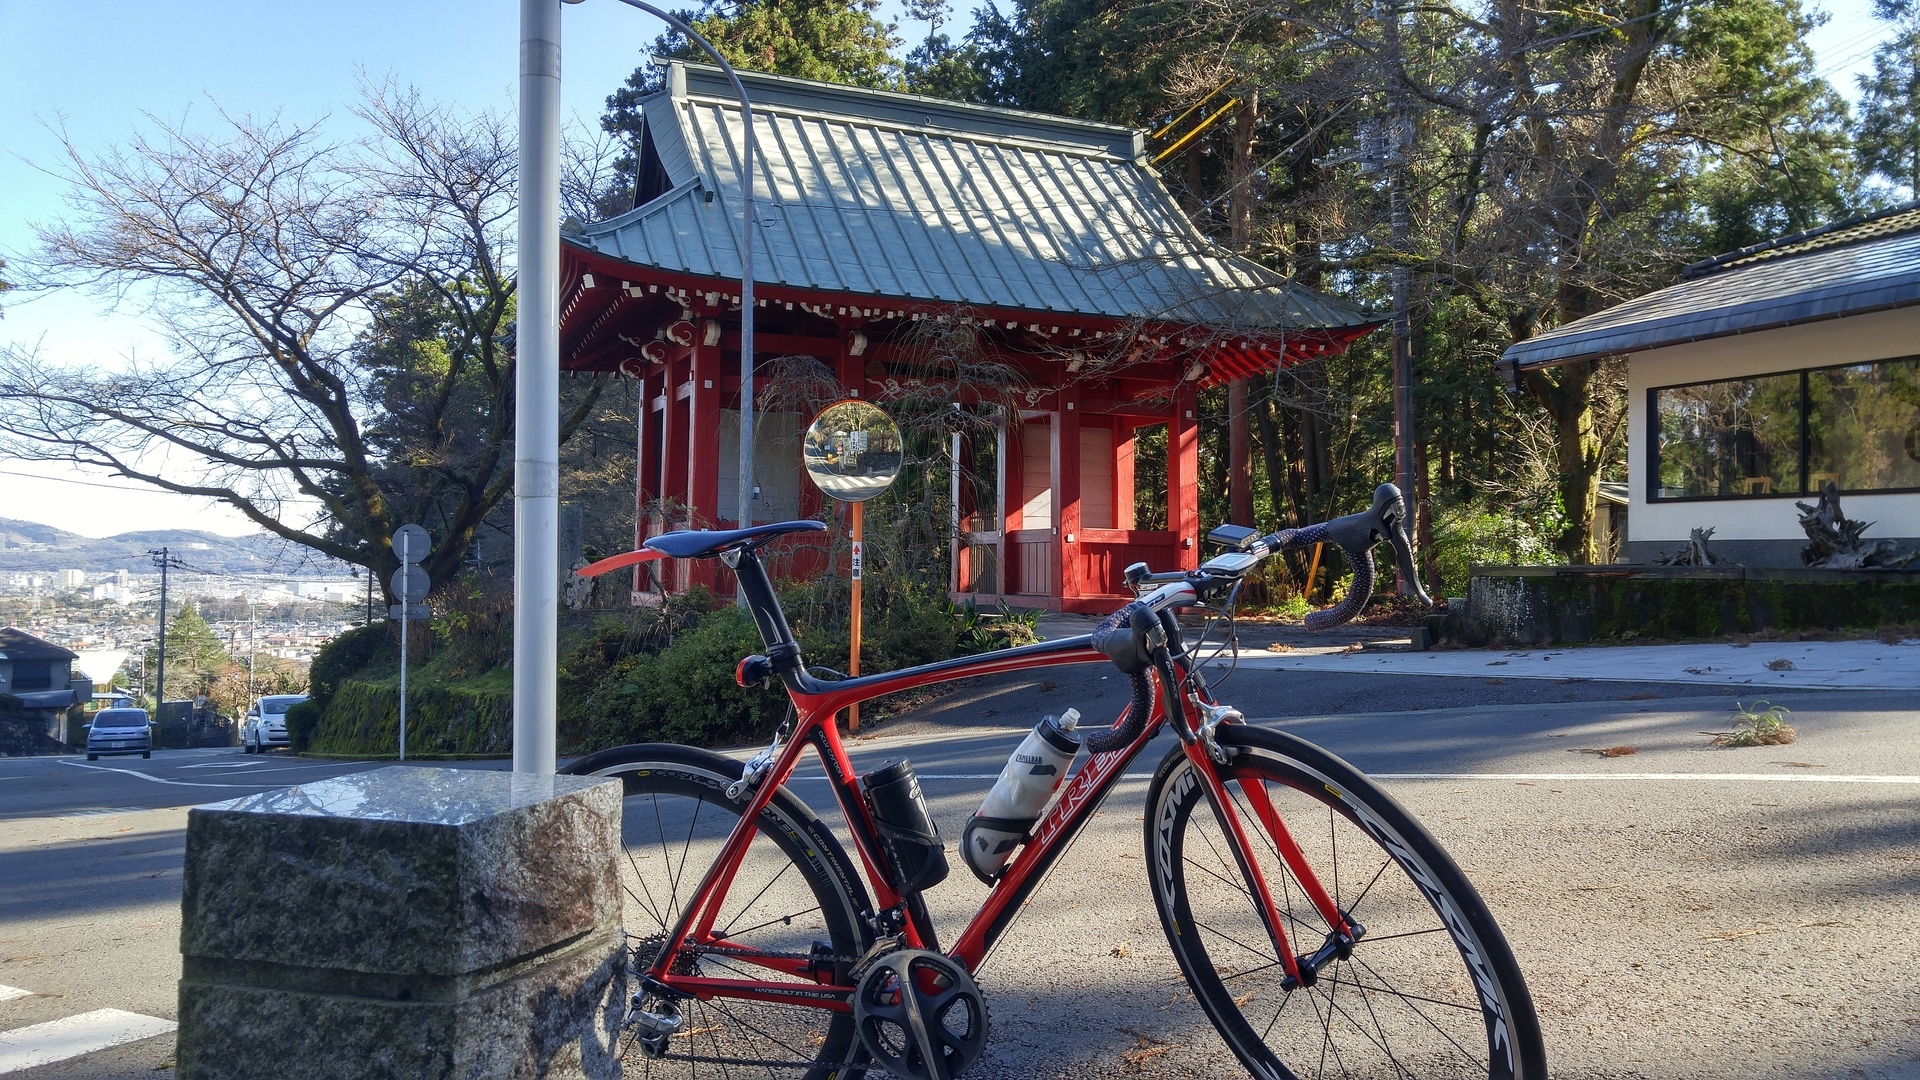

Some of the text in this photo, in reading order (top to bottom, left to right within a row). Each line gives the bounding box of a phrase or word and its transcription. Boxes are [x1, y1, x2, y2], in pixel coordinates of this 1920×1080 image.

[852, 558, 860, 577] 注意
[819, 730, 830, 748] OCLV
[1033, 747, 1126, 845] TRE
[813, 833, 853, 897] CONTINENTAL
[755, 987, 794, 996] HANDBUILT
